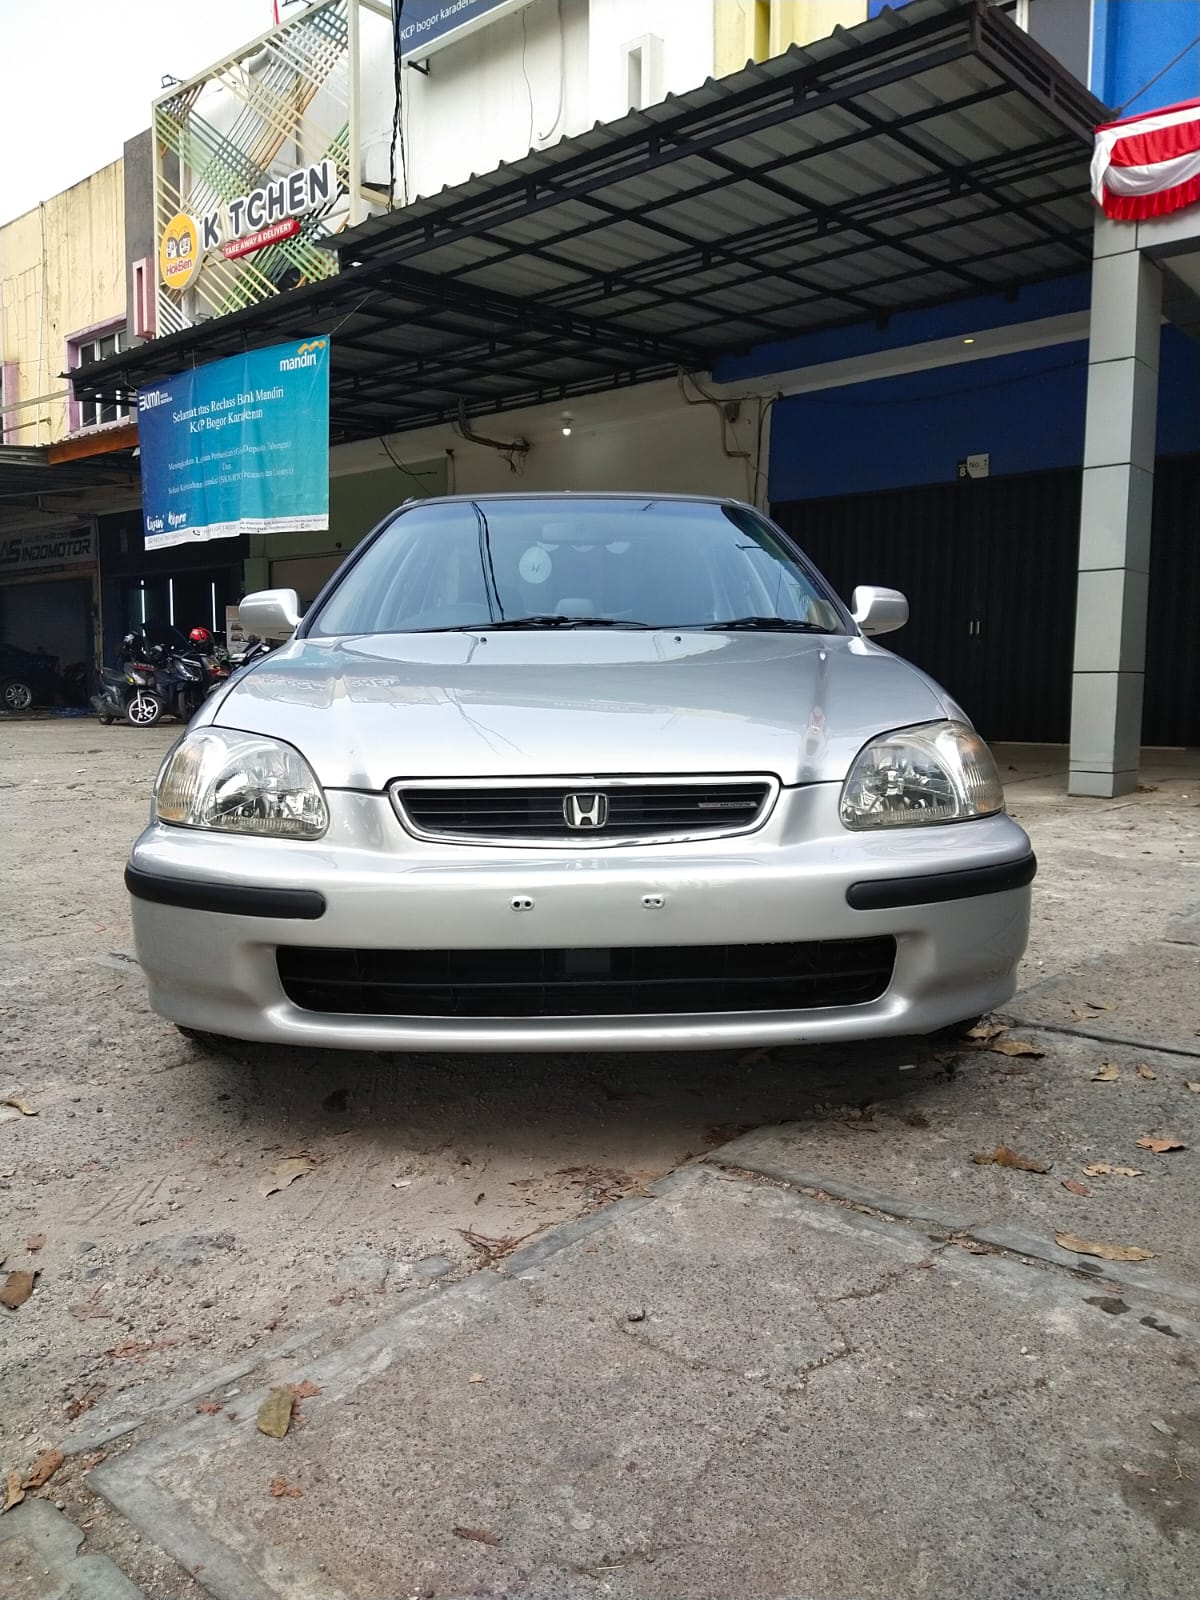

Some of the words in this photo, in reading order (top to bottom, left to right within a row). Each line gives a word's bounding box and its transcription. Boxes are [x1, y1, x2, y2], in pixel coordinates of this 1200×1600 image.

[400, 25, 415, 40] KCP
[416, 14, 439, 33] bogor
[225, 245, 240, 254] TAKE
[240, 236, 257, 249] AWAY
[263, 223, 291, 240] DELIVERY
[211, 396, 236, 412] Reclass
[255, 385, 284, 402] Mandiri
[206, 416, 227, 430] Bogor
[21, 538, 91, 562] INDOMOTOR
